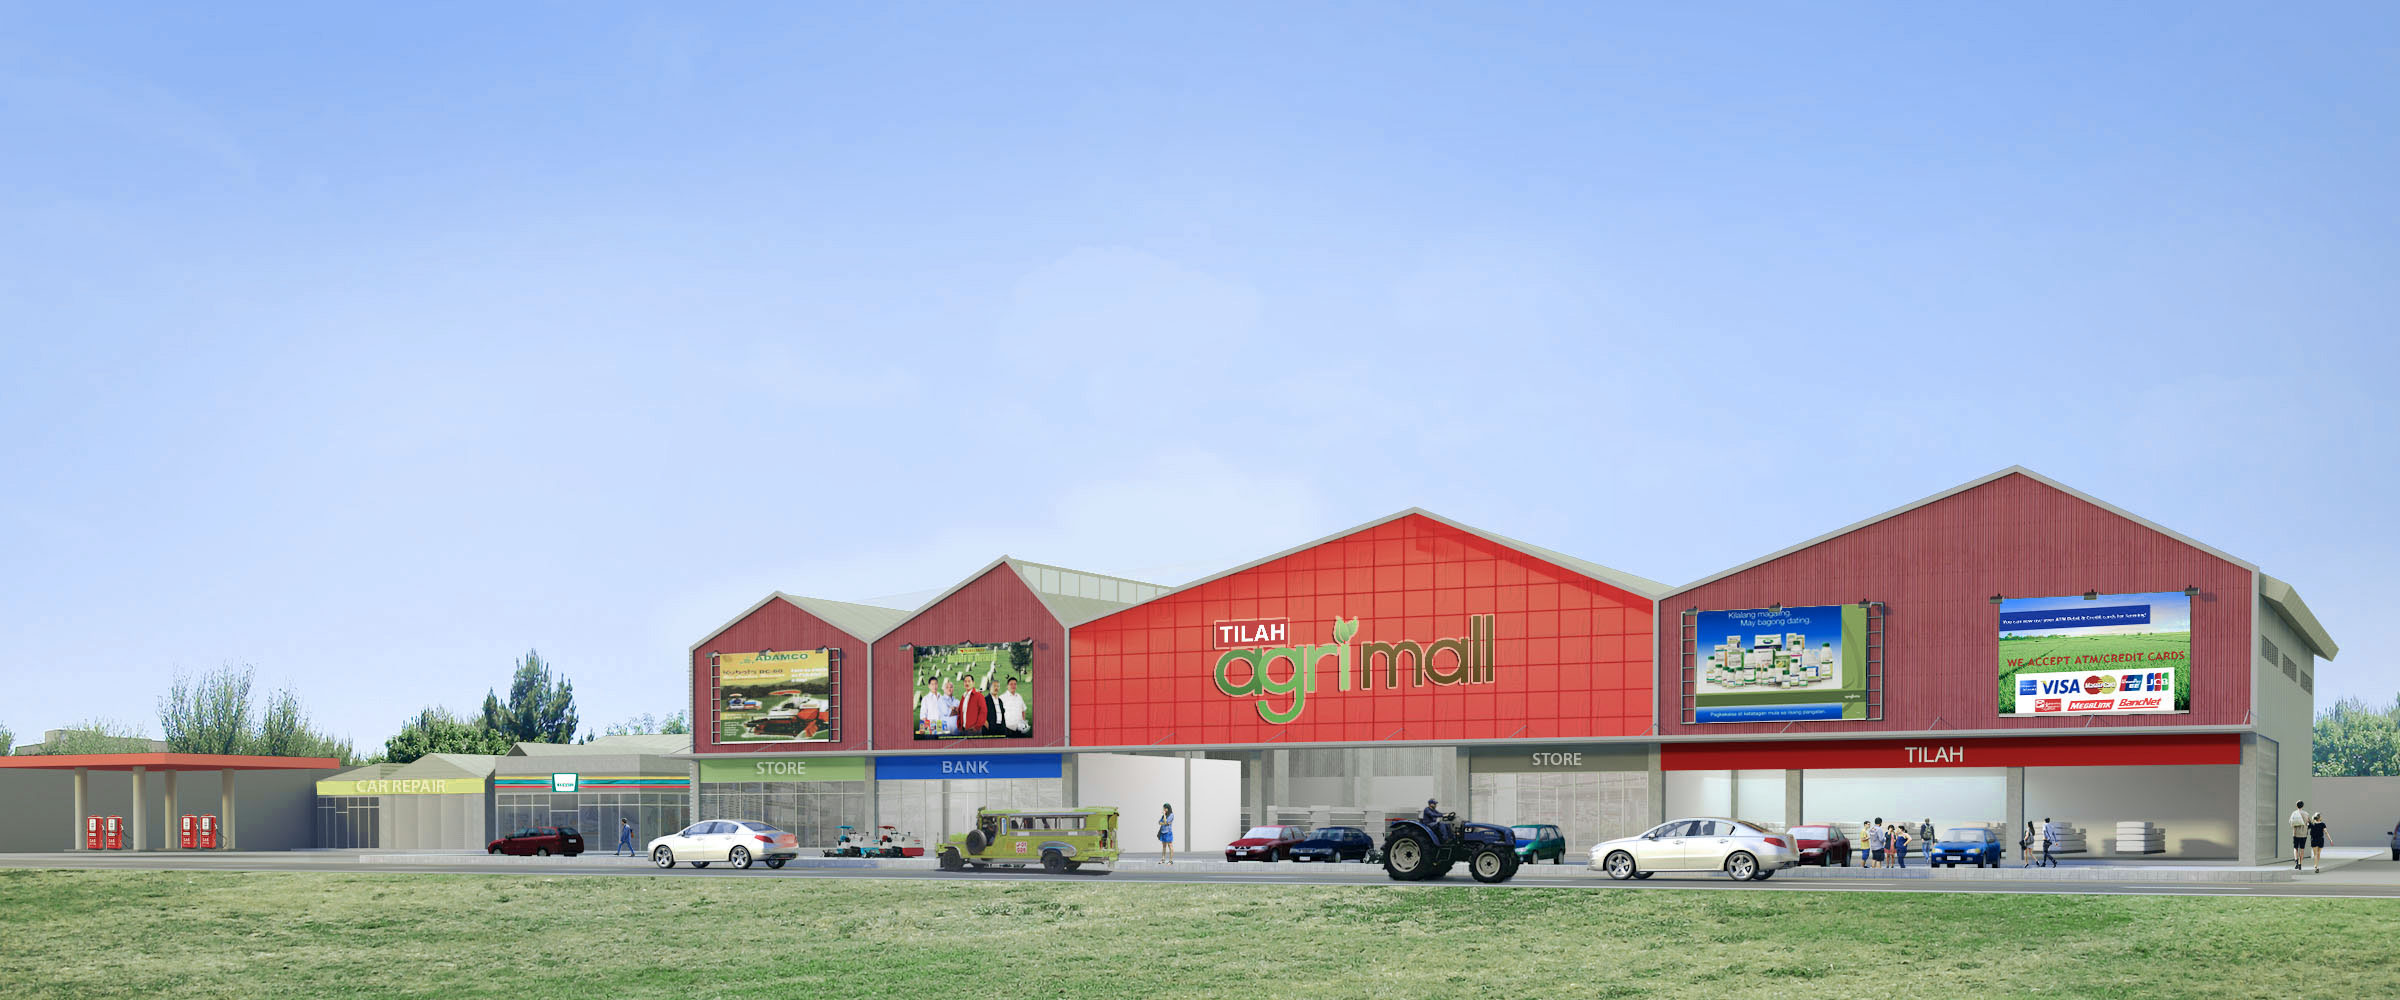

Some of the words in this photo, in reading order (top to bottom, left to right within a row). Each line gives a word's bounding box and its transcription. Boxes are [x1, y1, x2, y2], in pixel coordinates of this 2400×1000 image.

[1728, 611, 1756, 620] Kilalang
[1740, 619, 1756, 627] May
[1757, 618, 1785, 627] bagong
[1787, 616, 1812, 625] dating.
[1219, 624, 1285, 643] TILAH
[755, 653, 809, 661] ADAMCO
[2007, 658, 2024, 667] WE
[2027, 656, 2071, 666] ACCEPT
[2074, 652, 2144, 665] ATM/CREDIT
[2147, 650, 2185, 661] CARDS
[1214, 616, 1351, 724] agri
[1361, 614, 1495, 690] mall
[2041, 679, 2081, 695] VISA
[2119, 698, 2163, 707] BancNet
[1532, 752, 1582, 766] STORE
[1904, 745, 1964, 763] TILAH
[756, 761, 807, 775] STORE
[942, 760, 990, 774] BANK
[356, 779, 388, 793] CAR
[392, 779, 446, 793] REPAIR
